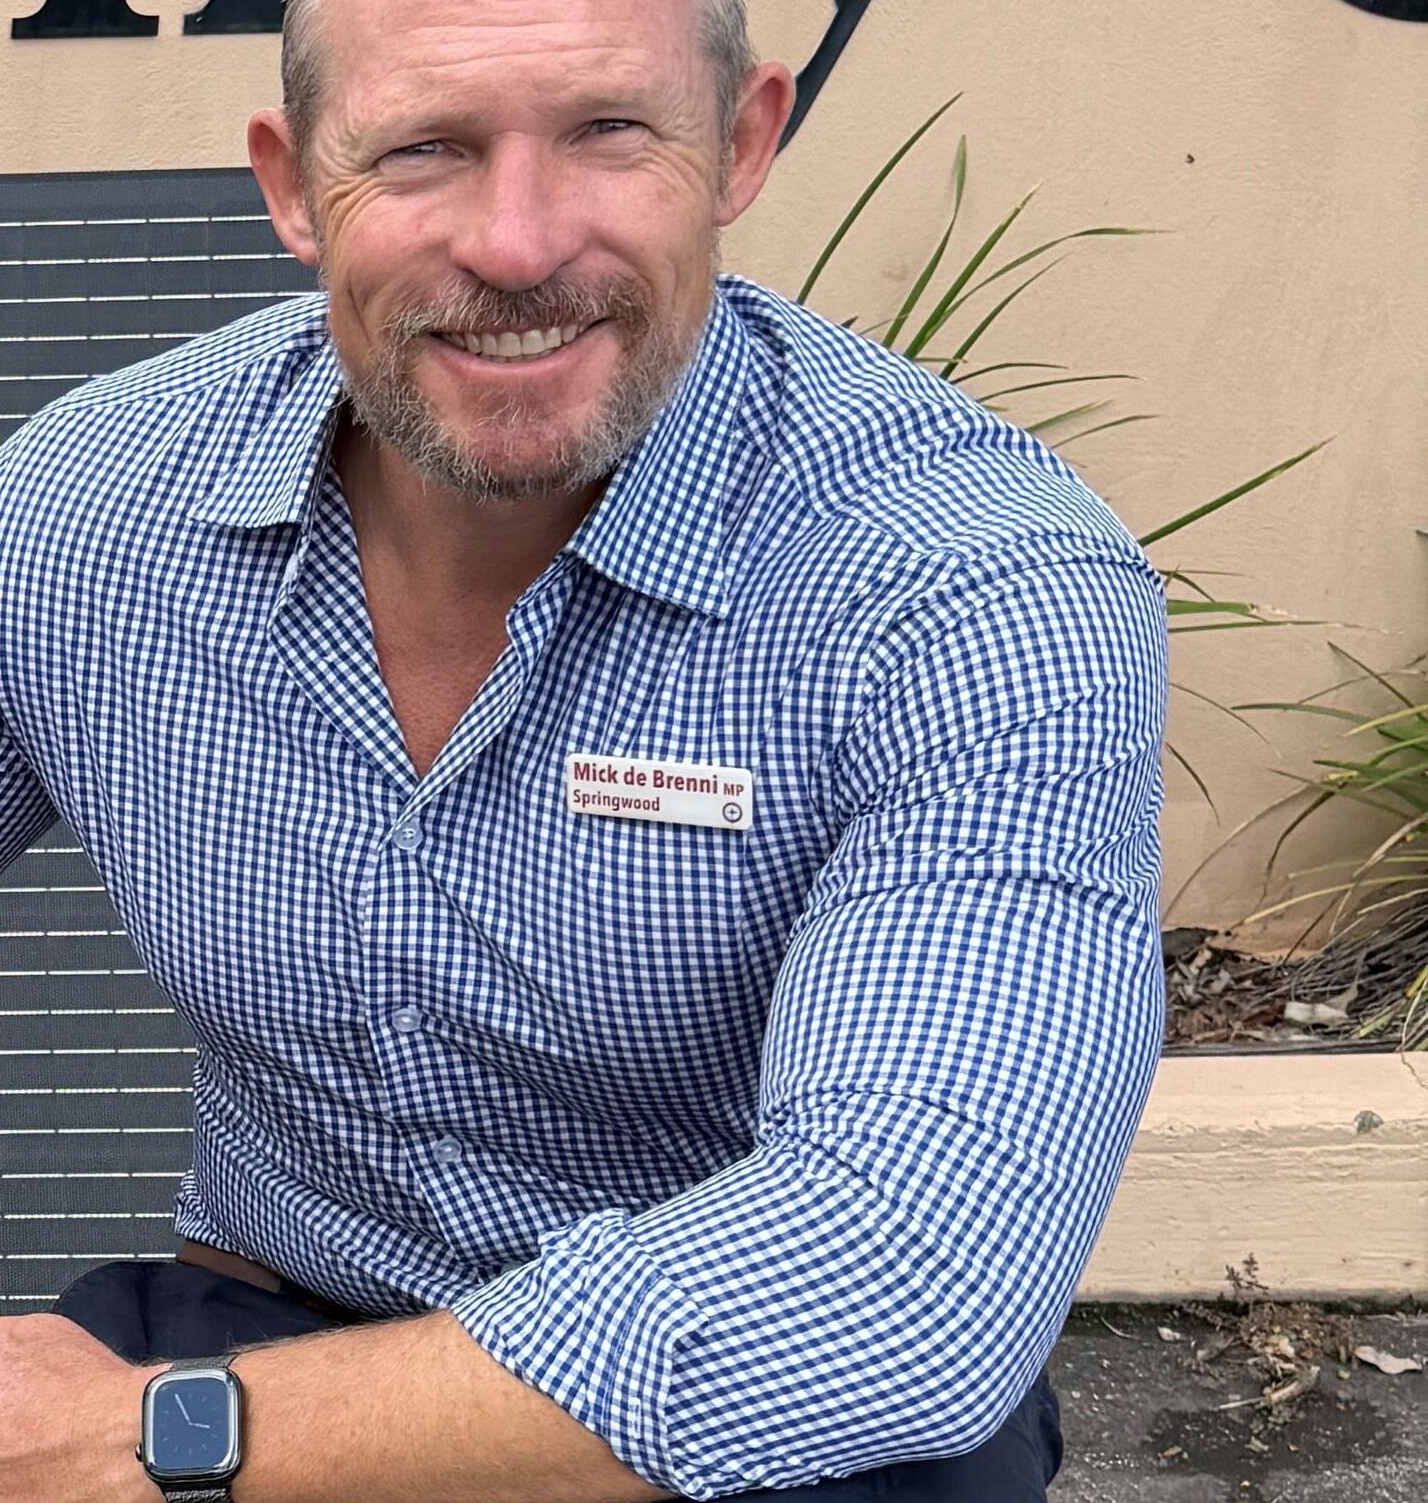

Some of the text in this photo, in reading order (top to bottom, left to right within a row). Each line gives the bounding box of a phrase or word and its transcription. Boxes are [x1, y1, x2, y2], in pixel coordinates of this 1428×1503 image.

[573, 761, 745, 797] Mick de Brenni MP
[572, 789, 661, 813] Springwood
